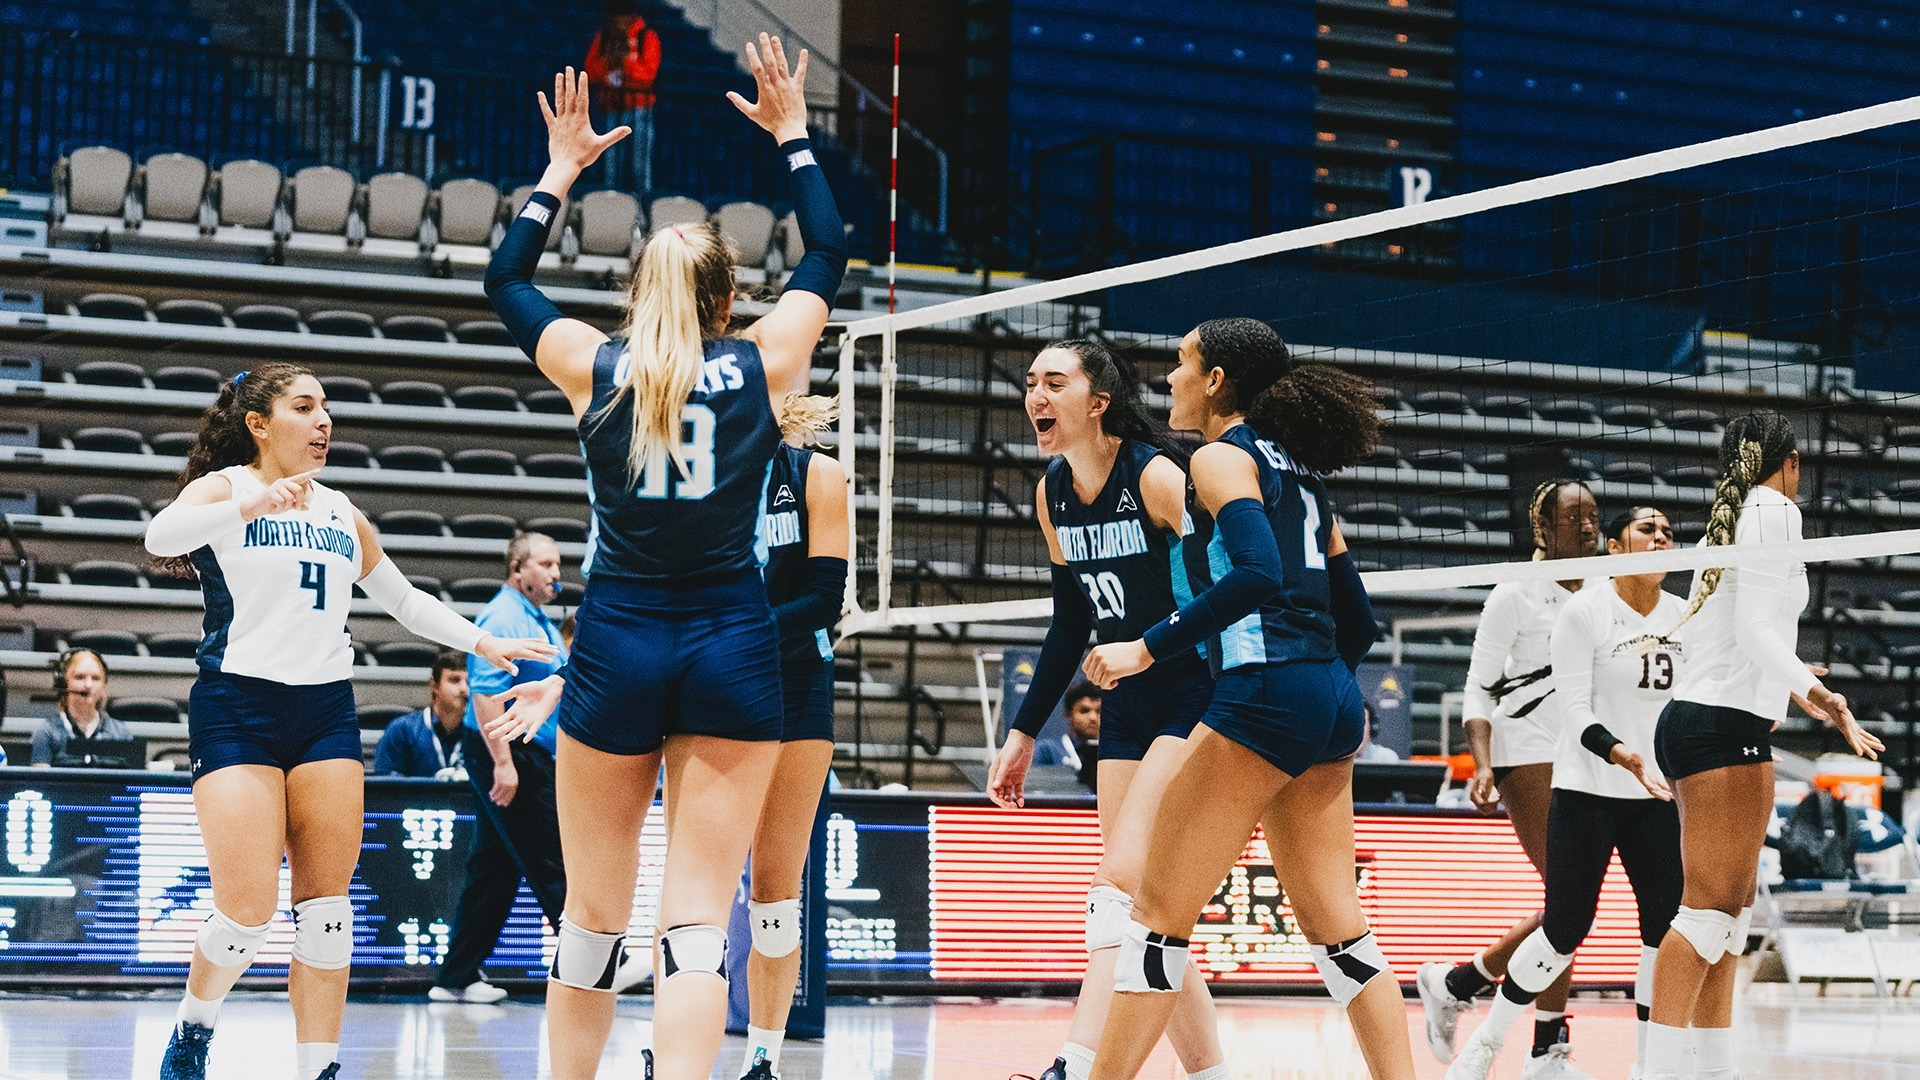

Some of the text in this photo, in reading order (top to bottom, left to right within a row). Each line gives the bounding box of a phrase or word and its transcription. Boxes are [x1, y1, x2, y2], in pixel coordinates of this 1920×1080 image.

[401, 76, 435, 128] 13
[636, 404, 716, 499] 13
[243, 516, 303, 548] NORTH
[1056, 525, 1089, 561] ORTH
[299, 560, 326, 611] 4
[1080, 571, 1126, 620] 20
[1638, 653, 1673, 690] 13
